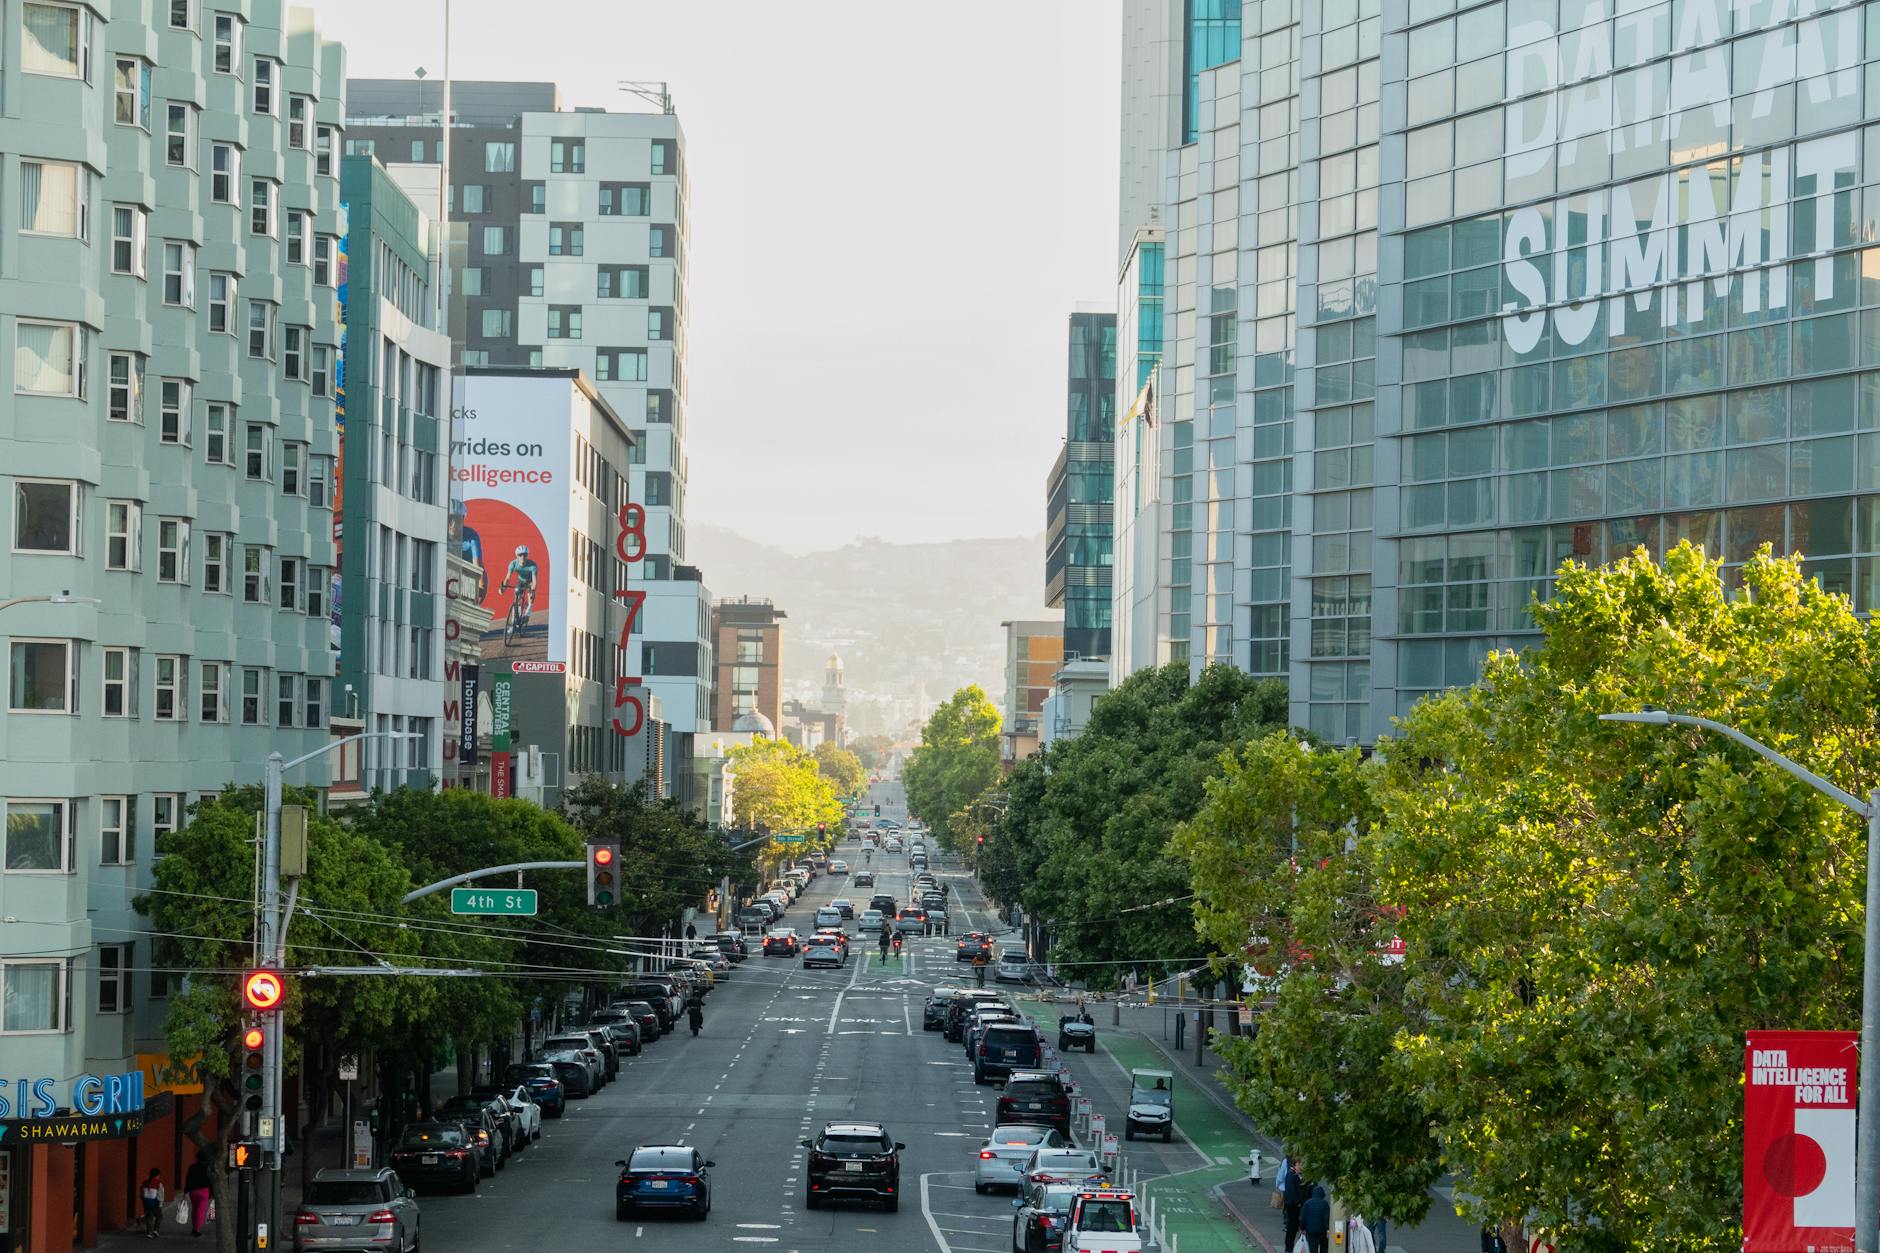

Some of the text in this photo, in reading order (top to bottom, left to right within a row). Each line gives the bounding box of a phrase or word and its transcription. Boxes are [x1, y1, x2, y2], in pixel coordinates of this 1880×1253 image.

[1502, 130, 1856, 355] SUMMIT
[516, 443, 543, 457] on
[612, 503, 647, 737] 875
[525, 663, 561, 672] CAPITOL
[463, 679, 476, 750] homebase
[494, 681, 503, 736] COMPUTERS
[500, 681, 511, 736] CENTRAL
[497, 761, 505, 777] THE
[467, 895, 522, 909] 4th St
[1753, 1050, 1788, 1067] DATA
[1752, 1068, 1847, 1085] INTELLIGENCE
[1795, 1085, 1848, 1103] FOR ALL
[20, 1122, 108, 1139] SHAWARMA
